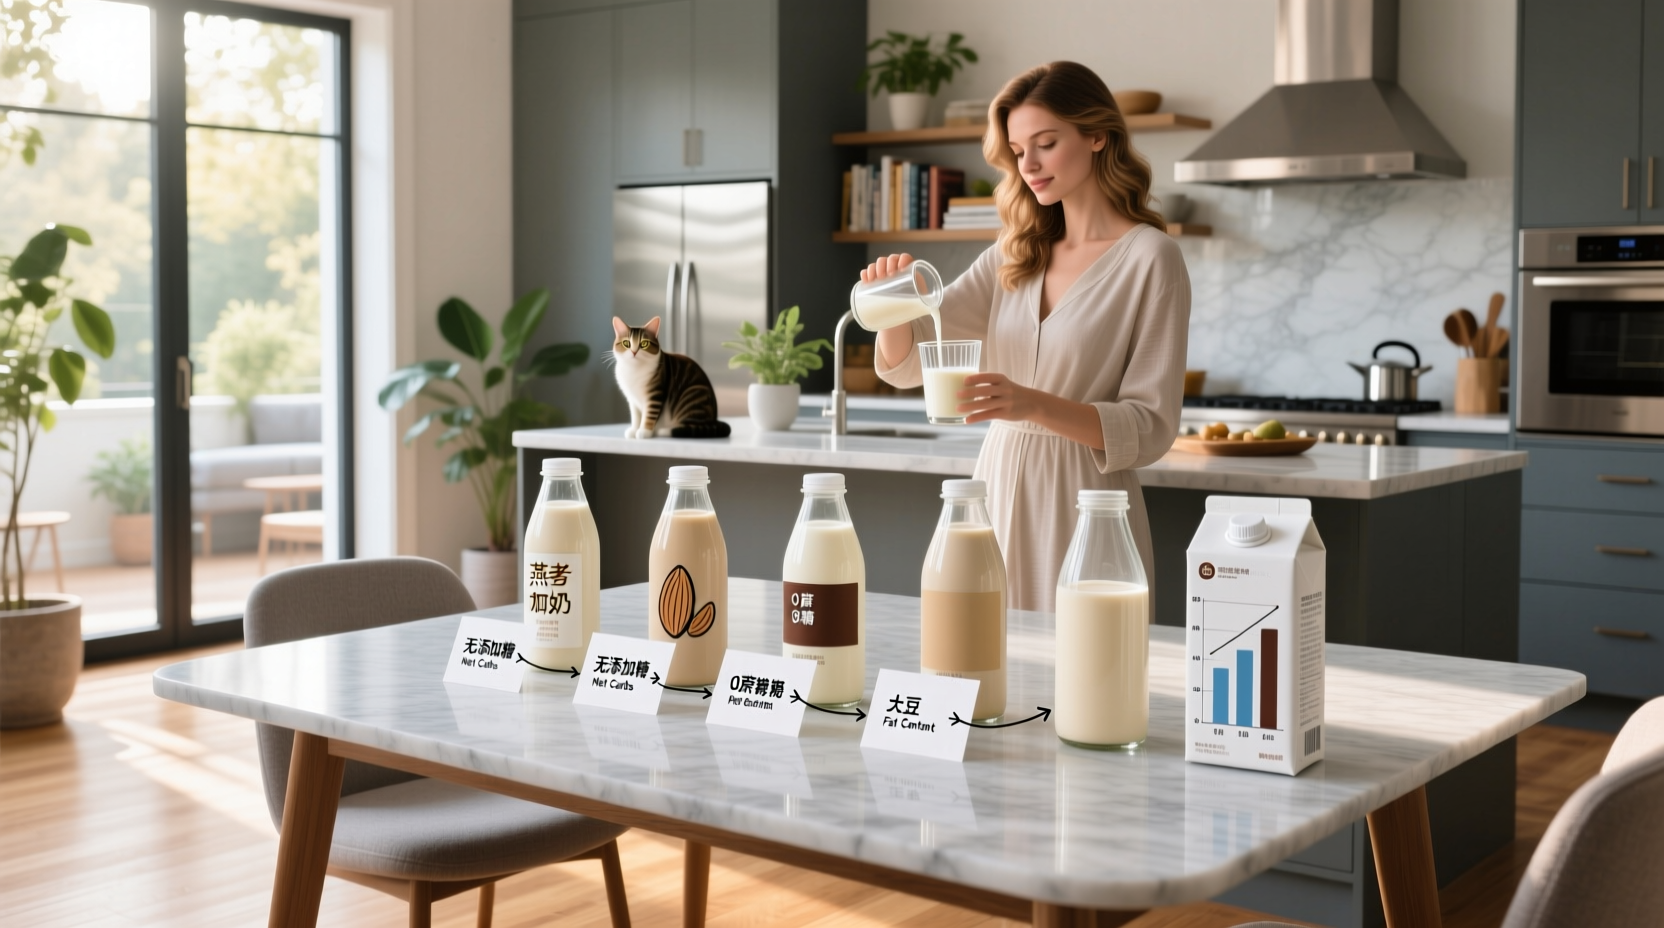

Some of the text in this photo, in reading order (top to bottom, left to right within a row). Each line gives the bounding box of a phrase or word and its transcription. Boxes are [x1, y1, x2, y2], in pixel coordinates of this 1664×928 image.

[592, 677, 607, 688] Net
[886, 693, 922, 716] 大豆
[882, 716, 898, 728] Fat
